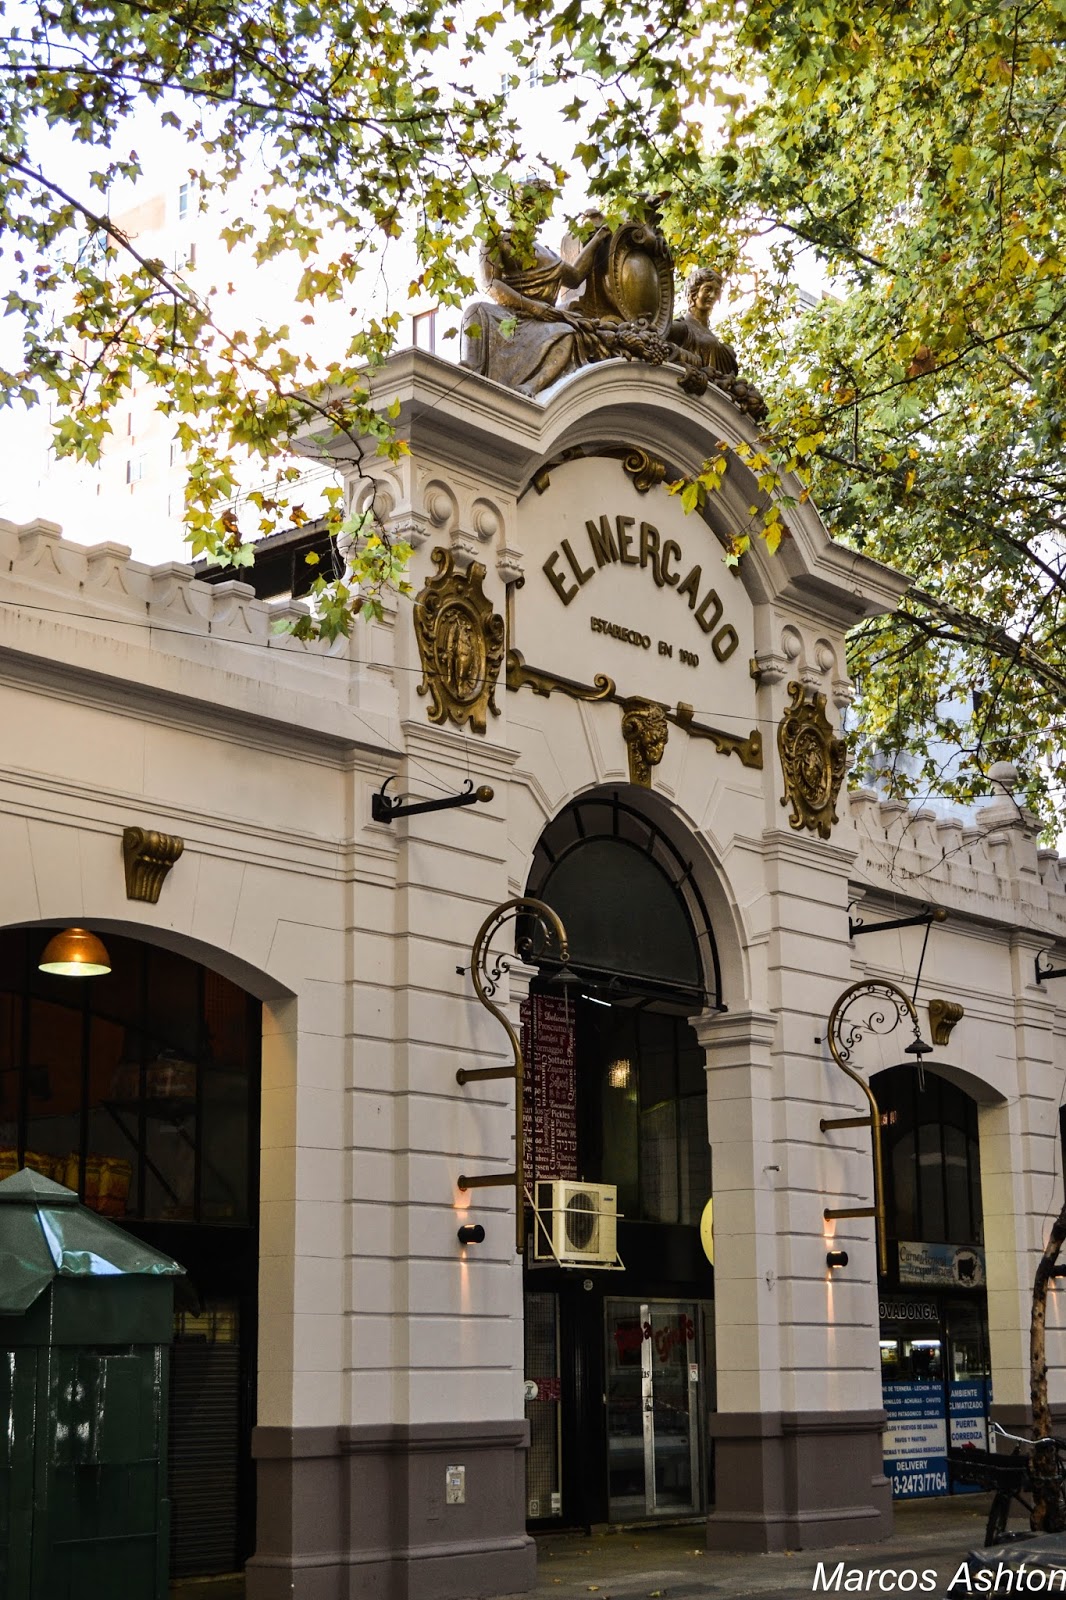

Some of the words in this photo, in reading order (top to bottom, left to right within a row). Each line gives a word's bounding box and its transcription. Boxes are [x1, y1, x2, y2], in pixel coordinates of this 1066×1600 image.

[542, 538, 596, 606] EL
[585, 514, 739, 663] MERCADO
[590, 616, 651, 649] ESTABLECIDO
[658, 640, 672, 658] EN
[879, 1302, 939, 1319] OVADONGA
[951, 1389, 978, 1397] AMBIENTE
[955, 1420, 978, 1429] PUERTA
[951, 1431, 983, 1441] CORREDIZA
[896, 1460, 928, 1471] DELIVERY
[890, 1472, 947, 1495] 13-2473/7764
